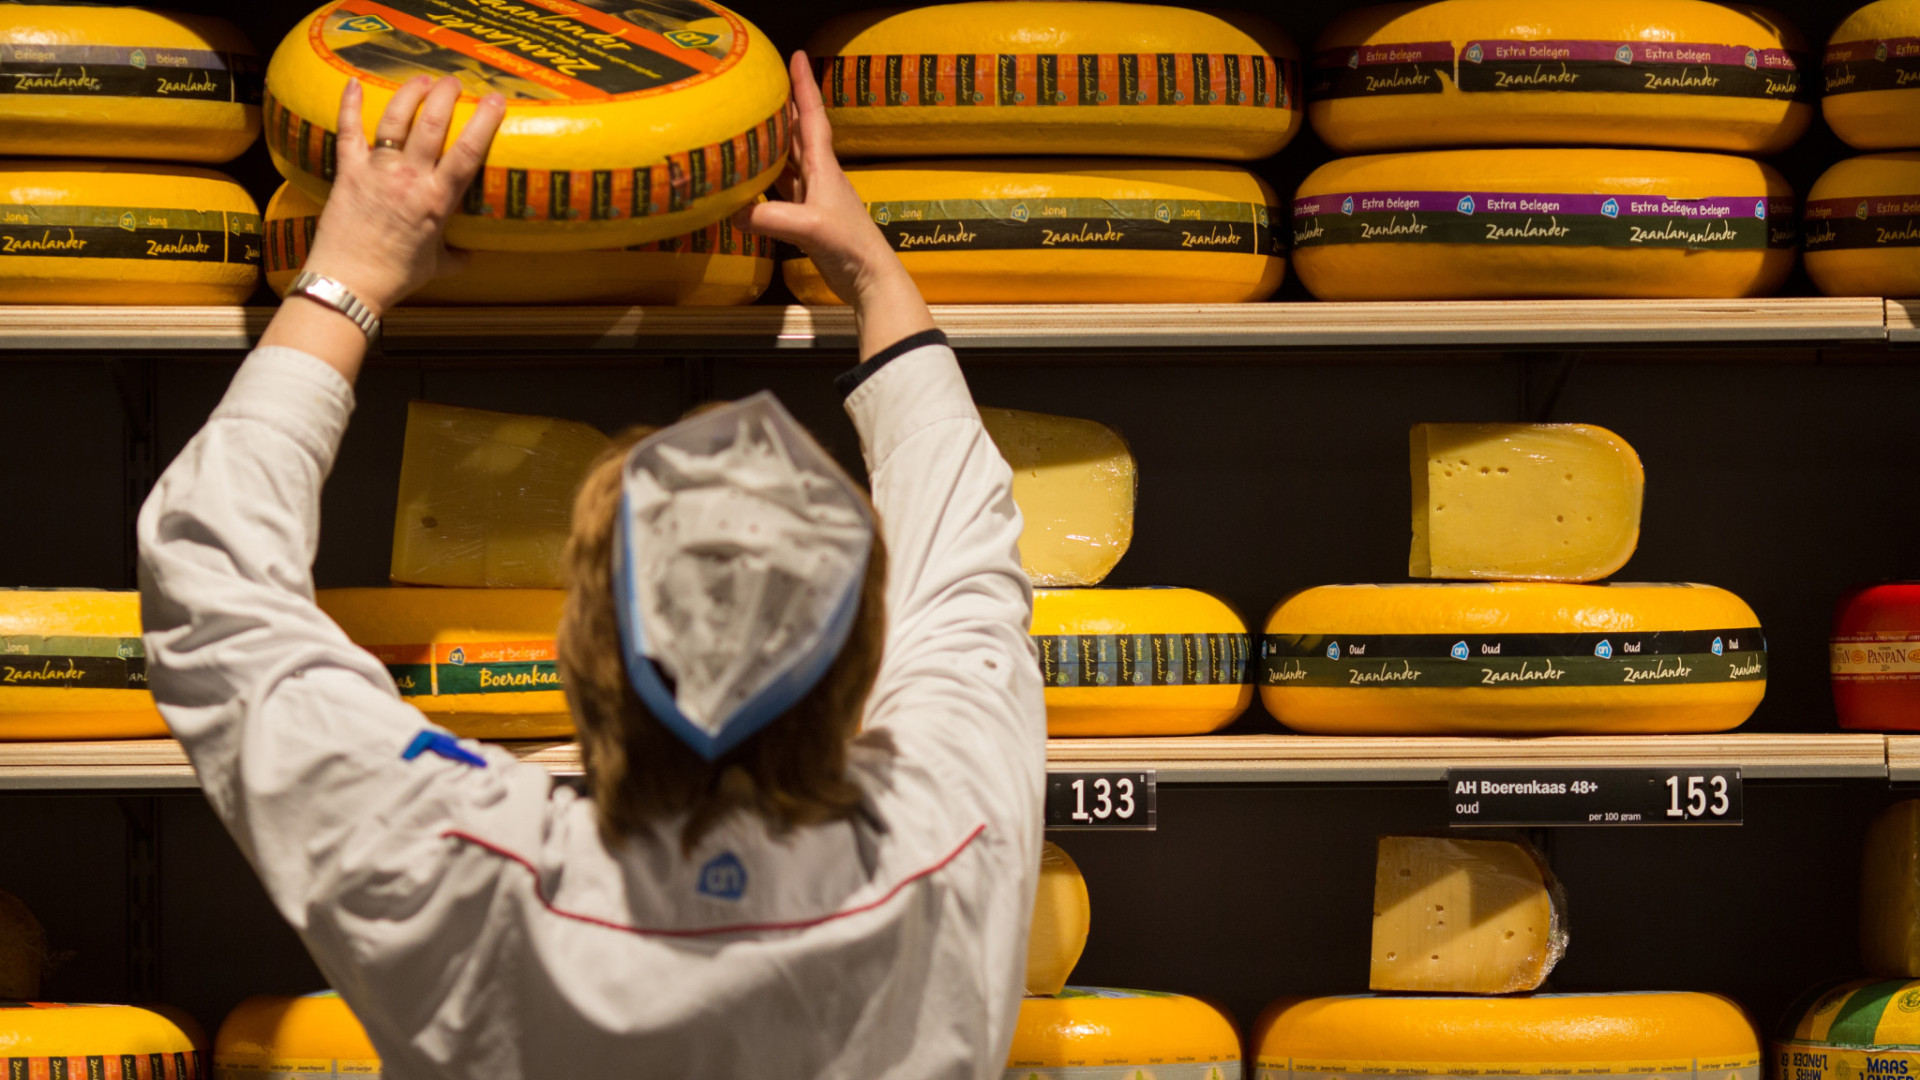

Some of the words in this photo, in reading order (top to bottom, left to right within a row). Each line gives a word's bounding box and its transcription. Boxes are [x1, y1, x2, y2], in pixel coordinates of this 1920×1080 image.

[466, 0, 632, 51] aanlander
[426, 13, 602, 76] Zaanlander
[1496, 47, 1526, 57] Extra
[1529, 47, 1570, 58] Belegen
[1645, 49, 1674, 60] Extra
[1676, 50, 1712, 61] Belegen
[156, 54, 188, 66] Belegen
[1366, 52, 1387, 62] Extra
[1390, 50, 1422, 61] Belegen
[1764, 55, 1782, 66] Extra
[15, 66, 100, 90] Zaanlander
[157, 71, 217, 93] Zaanlander
[924, 58, 935, 99] Zaanlander
[961, 58, 973, 99] Zaanlander
[1001, 58, 1013, 99] Zaanlander
[1042, 58, 1055, 99] Zaanlander
[1083, 58, 1096, 99] Zaanlander
[1123, 58, 1136, 99] Zaanlander
[1161, 58, 1174, 99] Zaanlander
[1366, 65, 1431, 91] Zaanlander
[1495, 62, 1580, 87] Zaanlander
[1644, 67, 1720, 89] Zaanlander
[900, 207, 922, 220] Jong
[1042, 205, 1067, 217] Jong
[1181, 207, 1201, 219] Jong
[1362, 198, 1385, 209] Extra
[1386, 197, 1420, 209] Belegen
[1487, 199, 1517, 210] Extra
[1519, 199, 1560, 213] Belegen
[1631, 202, 1659, 213] Extra
[1700, 205, 1730, 217] Belegen
[1877, 203, 1900, 213] Extra
[3, 212, 29, 224] Jong
[148, 217, 168, 229] Jong
[1361, 213, 1428, 239] Zaanlander
[1486, 215, 1570, 240] Zaanlander
[2, 229, 87, 251] Zaanlander
[899, 221, 977, 248] Zaanlander
[1042, 220, 1125, 245] Zaanlander
[1181, 223, 1241, 247] Zaanlander
[1293, 217, 1324, 245] Zaanlander
[147, 233, 209, 255] Zaanlander
[5, 643, 29, 655] Jong
[479, 648, 505, 661] Jong
[507, 647, 548, 660] Belegen
[1349, 643, 1365, 655] Oud
[1481, 643, 1501, 655] Oud
[1624, 641, 1641, 653] Oud
[1729, 639, 1739, 650] Oud
[1043, 640, 1056, 682] Zaanlander
[1083, 639, 1095, 681] Zaanlander
[1120, 639, 1132, 681] Zaanlander
[1729, 653, 1762, 679] Zaanlander
[1867, 649, 1906, 664] PANPAN
[3, 658, 86, 683] Zaanlander
[1269, 660, 1308, 683] Zaanlander
[1349, 659, 1422, 684] Zaanlander
[1481, 658, 1565, 684] Zaanlander
[1623, 656, 1692, 683] Zaanlander
[1455, 781, 1477, 794] AH
[1480, 780, 1566, 794] Boerenkaas
[1570, 781, 1599, 794] 48+
[1666, 775, 1729, 820] 1,53
[1071, 778, 1136, 824] 1,33
[1455, 801, 1479, 814] oud
[1588, 813, 1602, 821] per
[1604, 812, 1619, 821] 100
[1621, 814, 1641, 822] gram
[1866, 1057, 1908, 1074] MAAS
